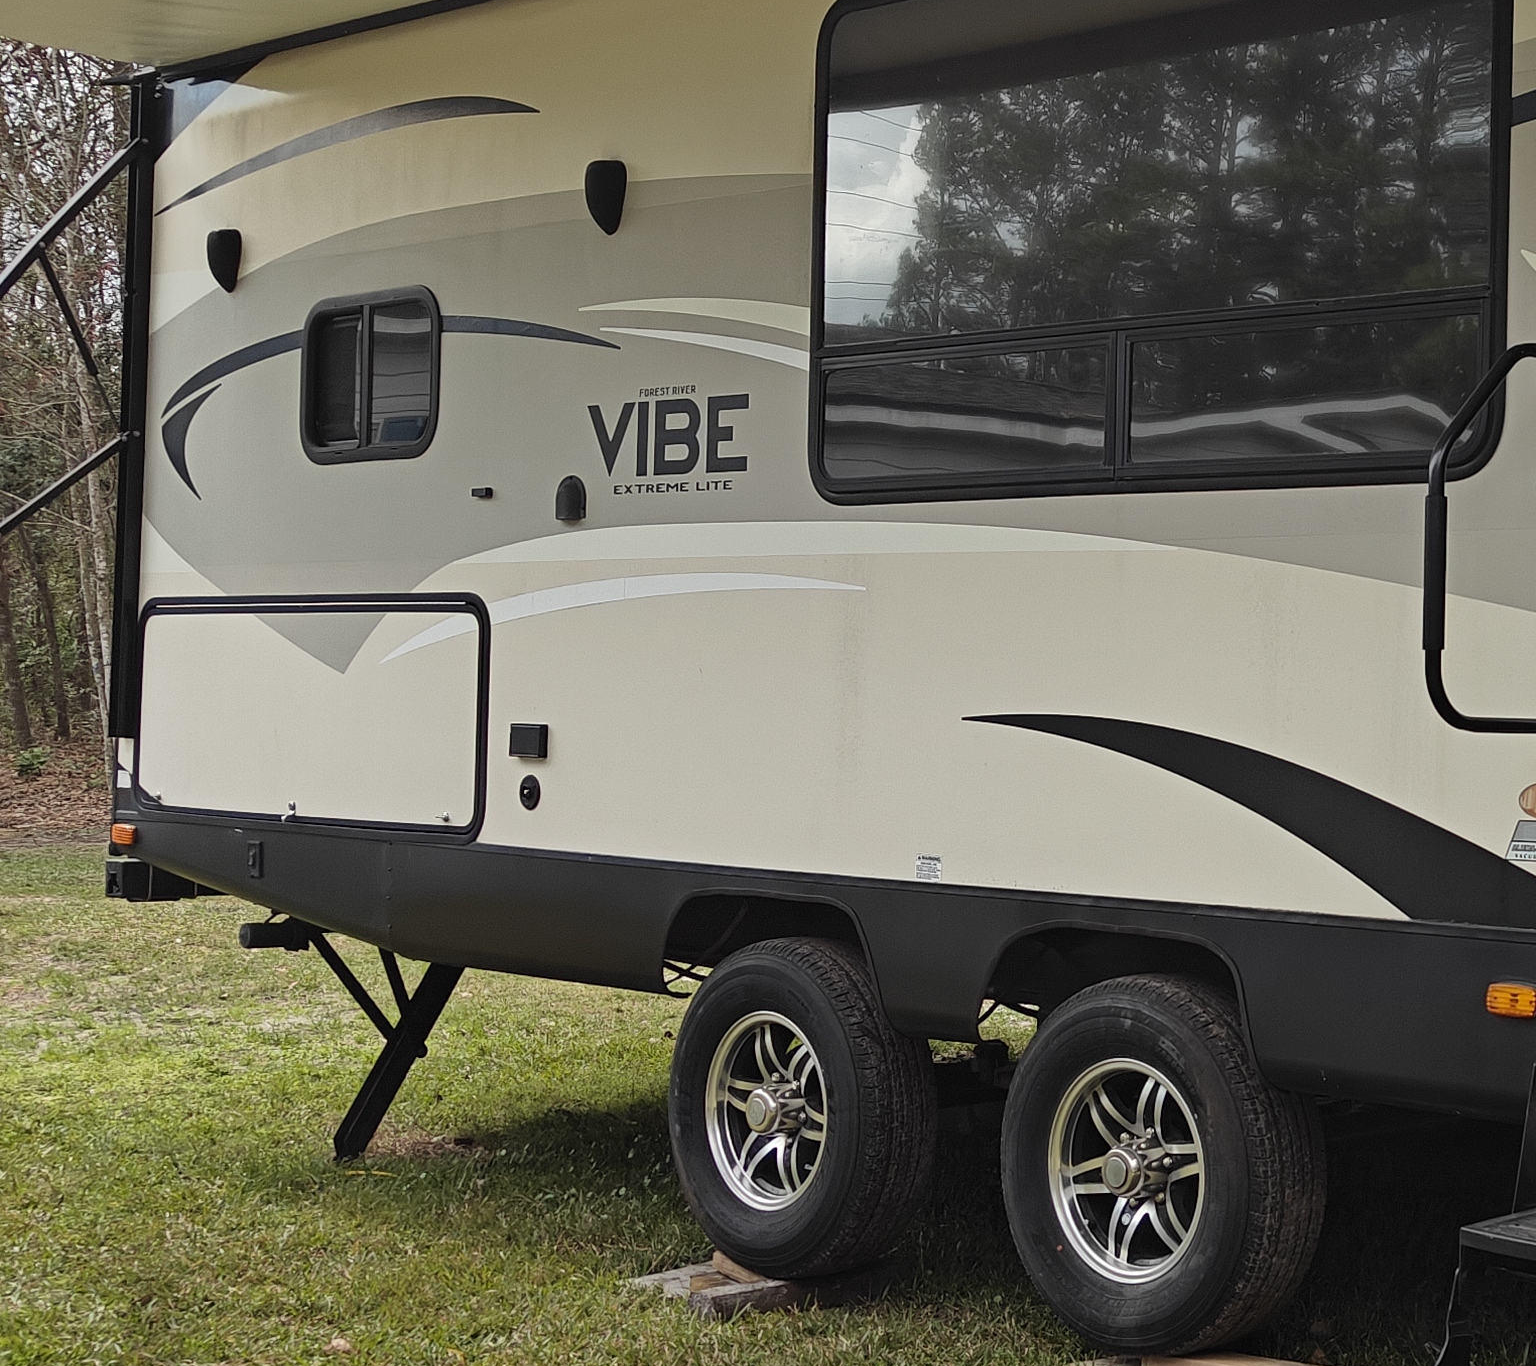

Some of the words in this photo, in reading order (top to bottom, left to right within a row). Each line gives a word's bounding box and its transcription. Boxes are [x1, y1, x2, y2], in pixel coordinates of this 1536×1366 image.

[638, 387, 670, 398] FOREST
[672, 385, 697, 395] RIVER
[587, 394, 749, 477] VIBE
[613, 482, 689, 495] EXTREME
[696, 480, 733, 492] LITE
